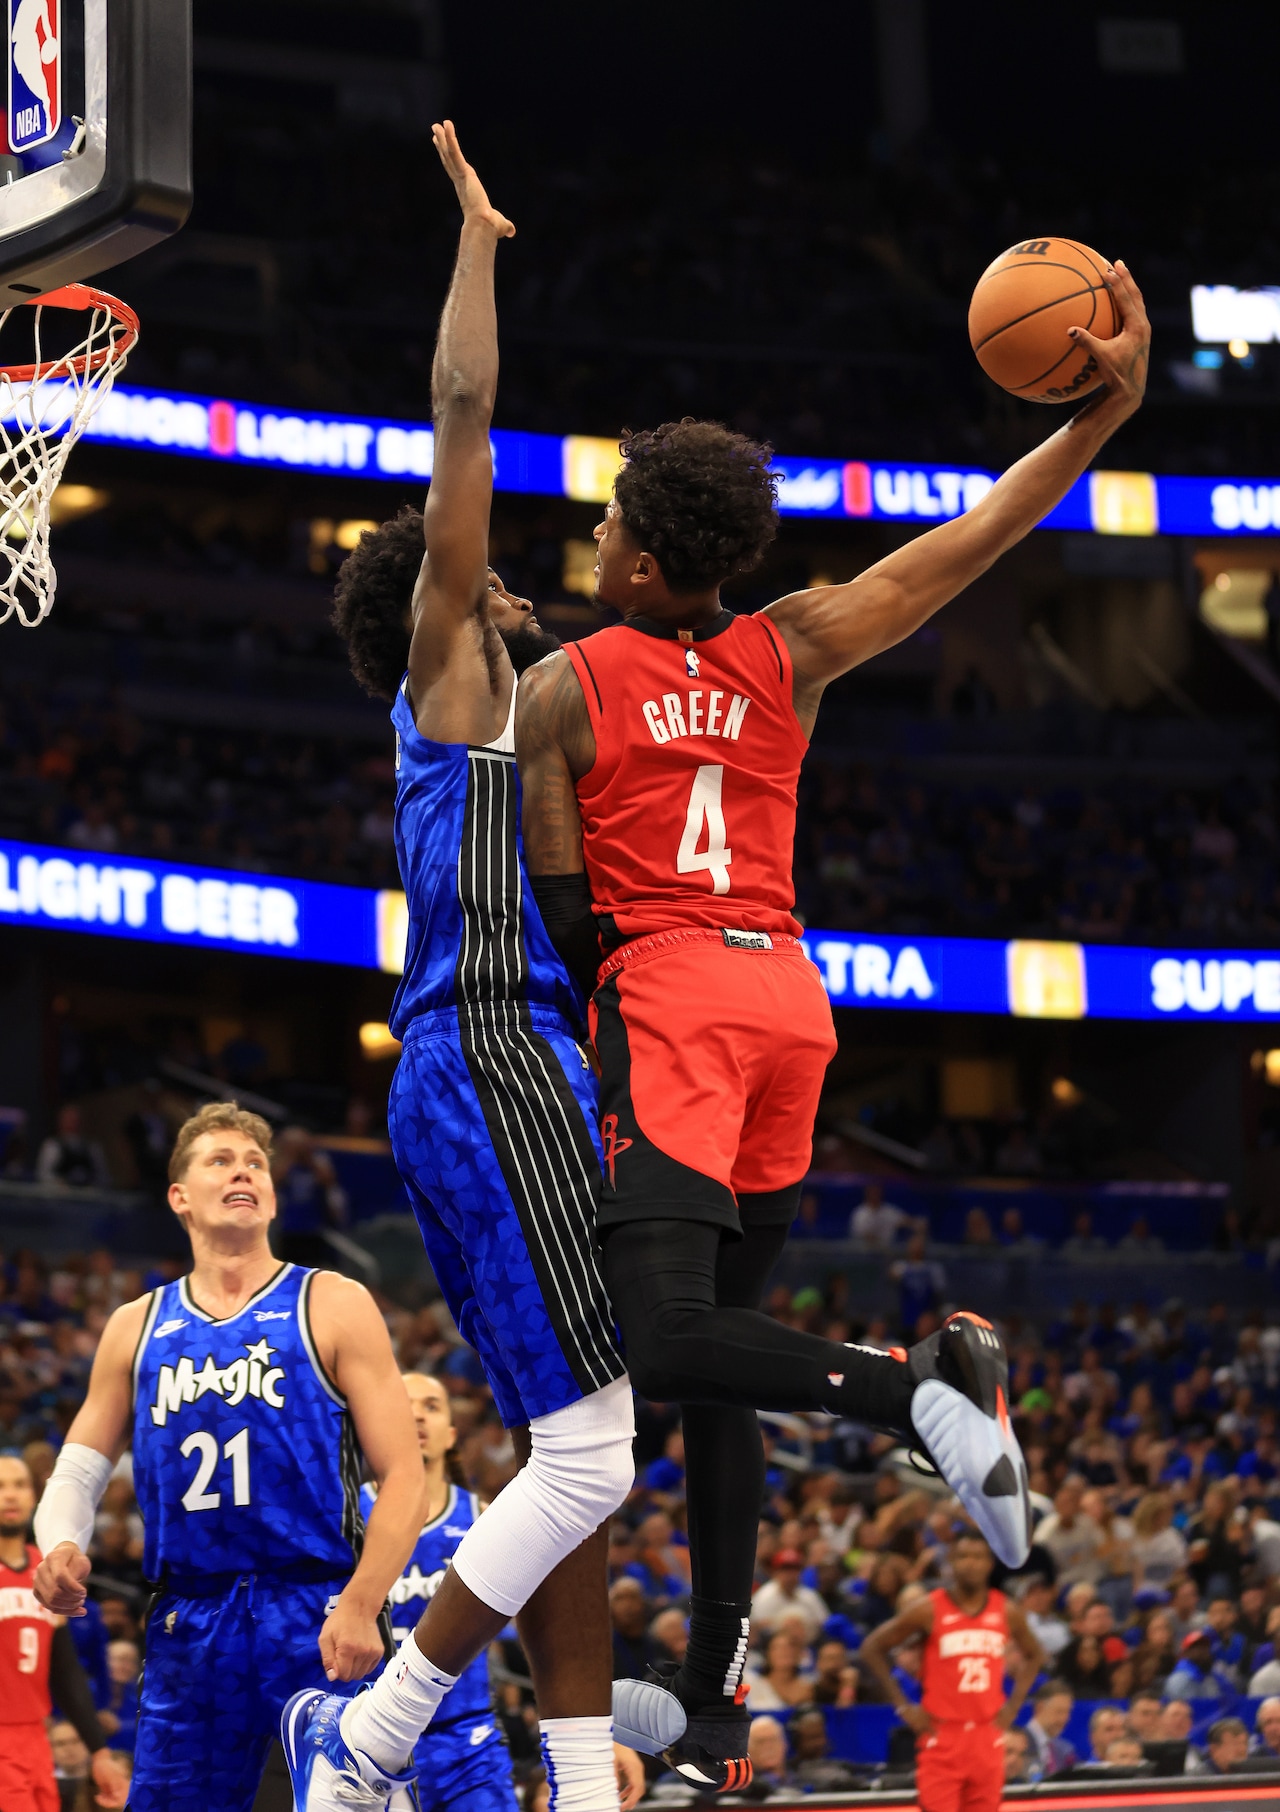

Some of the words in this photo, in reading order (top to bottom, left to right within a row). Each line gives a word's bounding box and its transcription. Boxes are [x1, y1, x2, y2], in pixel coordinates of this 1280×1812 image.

[16, 103, 41, 141] NBA
[236, 411, 375, 470] LIGHT
[641, 690, 751, 745] GREEN
[676, 764, 732, 895] 4
[161, 873, 300, 948] BEER
[801, 940, 933, 999] TRA
[179, 1427, 250, 1512] 21
[18, 1626, 39, 1675] 9
[957, 1656, 991, 1693] 25
